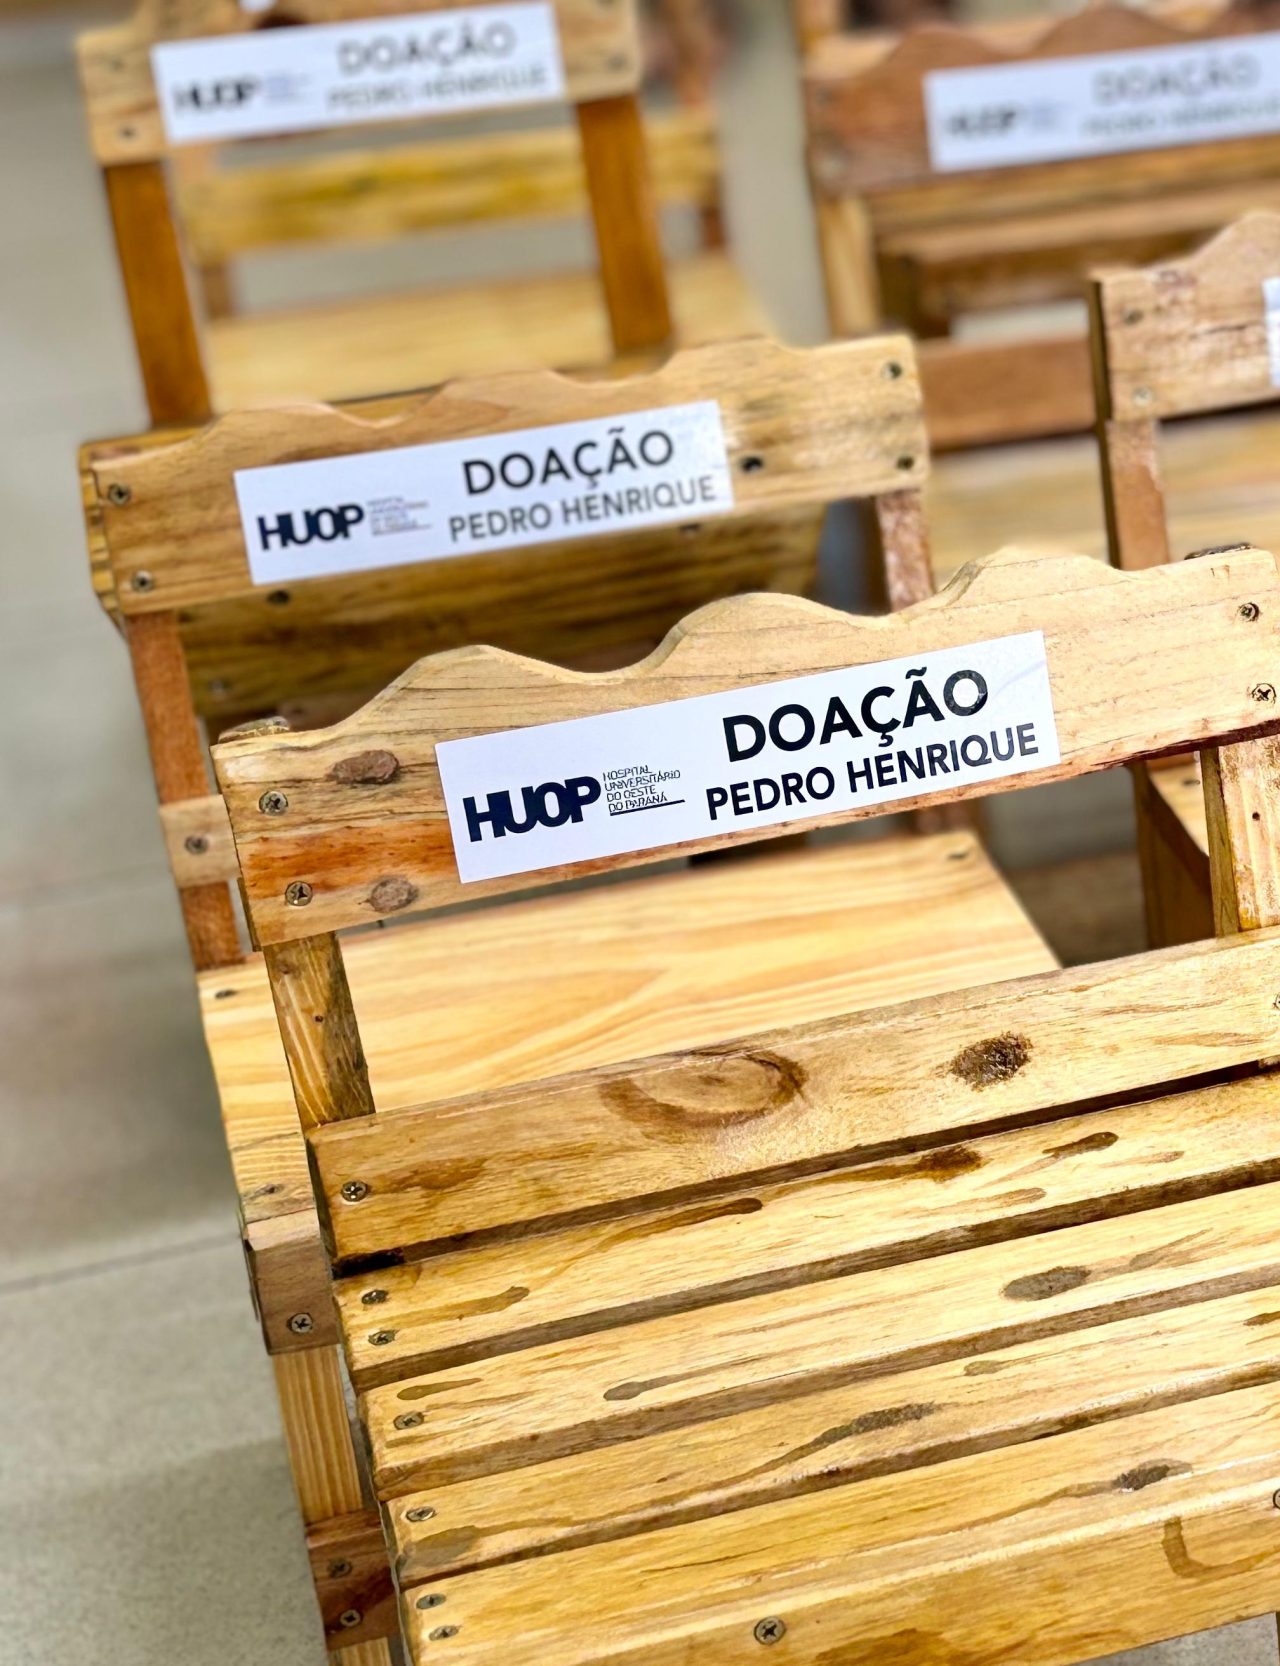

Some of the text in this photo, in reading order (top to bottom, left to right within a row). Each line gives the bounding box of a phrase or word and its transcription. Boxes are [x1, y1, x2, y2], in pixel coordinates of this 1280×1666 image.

[462, 427, 675, 496] DOAÇÃO
[257, 503, 365, 551] HUOP
[449, 504, 552, 543] PEDRO
[561, 475, 717, 526] HENRIQUE
[723, 669, 989, 763] DOAÇÃO
[603, 765, 652, 782] HOSPITAL
[607, 785, 656, 802] DO OESTE
[705, 723, 1039, 820] PEDRO HENRIQUE
[462, 774, 602, 843] HUOP
[609, 803, 623, 812] DO
